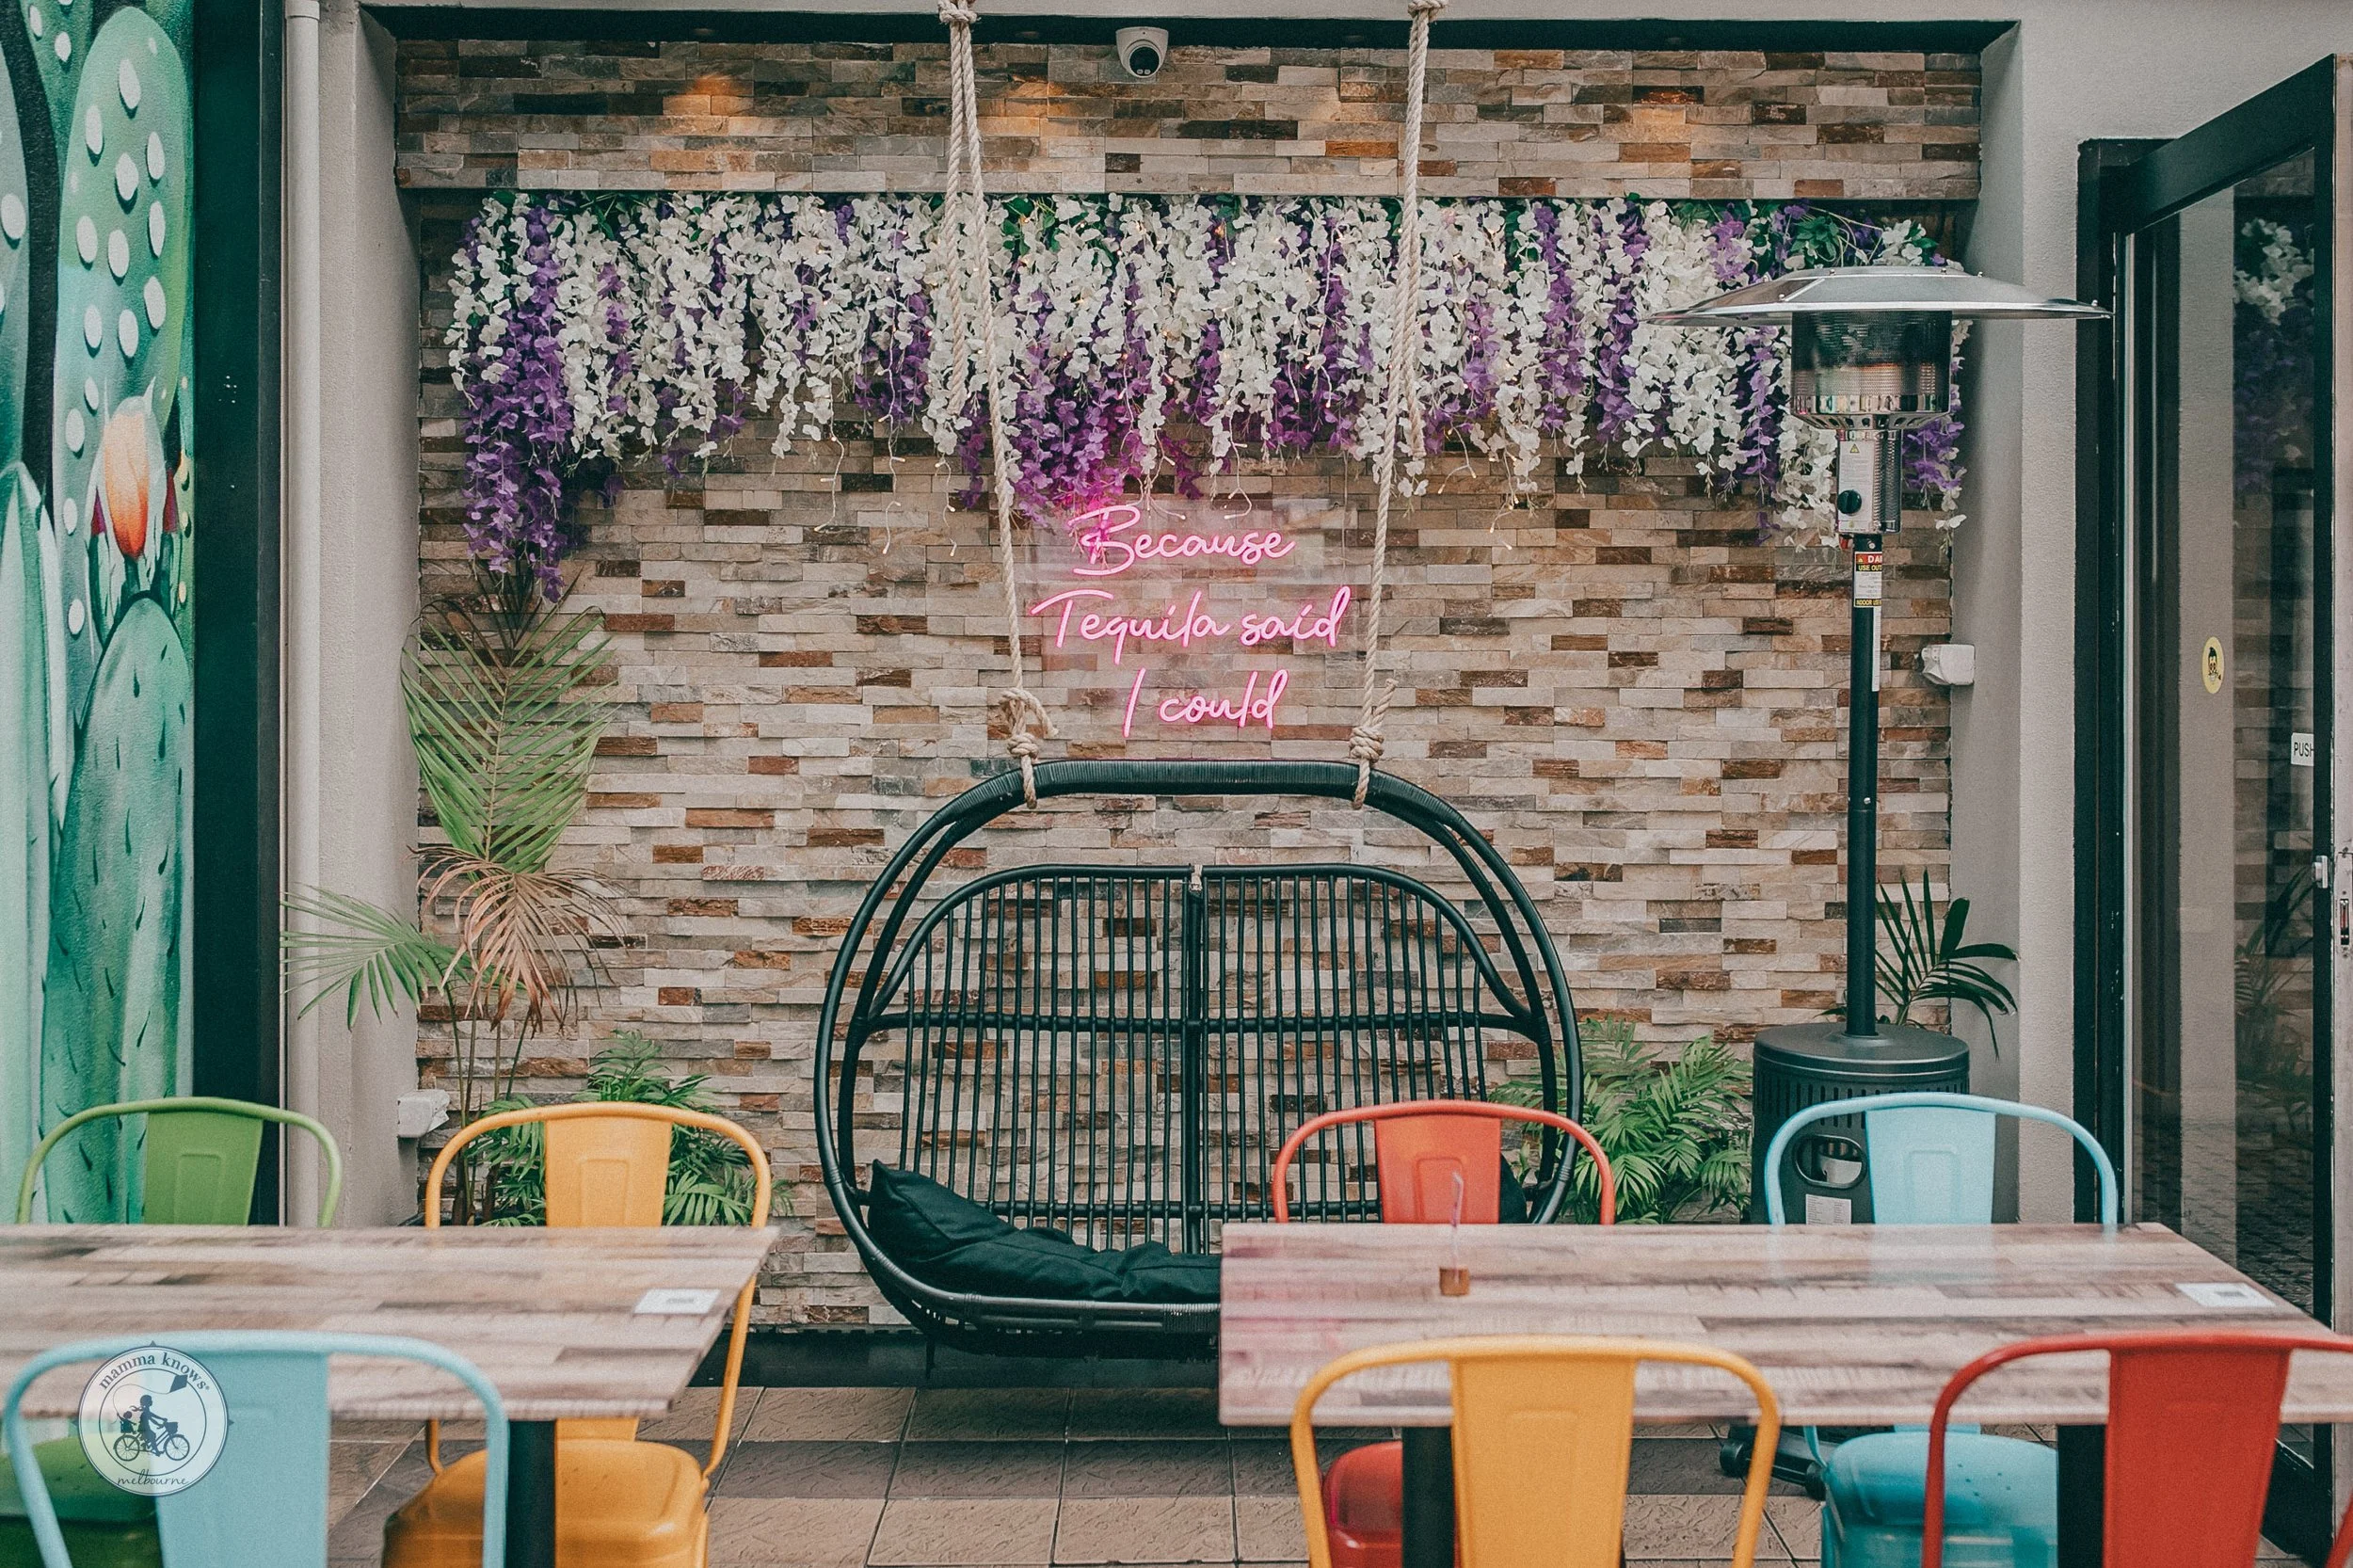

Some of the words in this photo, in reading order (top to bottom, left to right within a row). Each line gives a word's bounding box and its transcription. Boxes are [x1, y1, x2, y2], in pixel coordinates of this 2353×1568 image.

[1067, 504, 1296, 575] Because
[1031, 589, 1229, 664] Tequila
[1240, 584, 1352, 648] said
[1122, 667, 1145, 738] I
[1159, 667, 1289, 730] could
